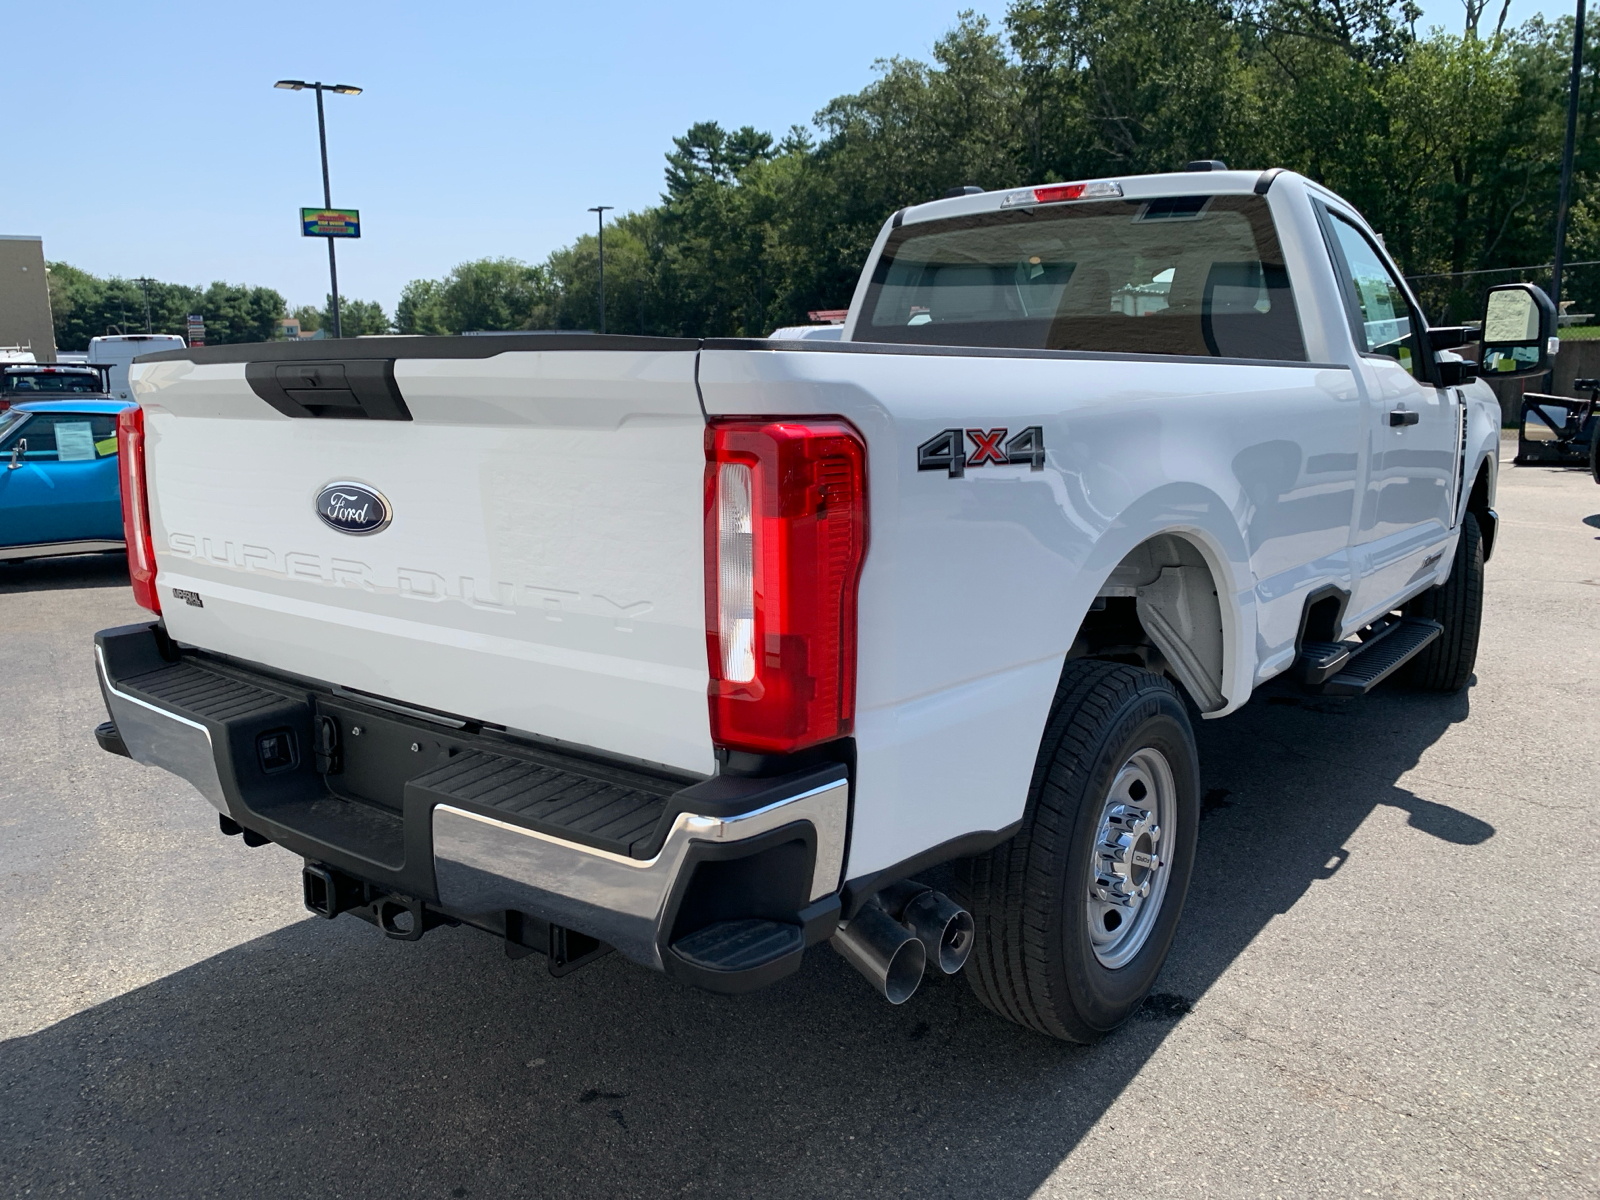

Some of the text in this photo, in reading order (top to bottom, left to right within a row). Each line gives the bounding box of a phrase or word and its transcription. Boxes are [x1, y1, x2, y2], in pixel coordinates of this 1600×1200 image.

[327, 492, 369, 524] Ford
[168, 532, 655, 633] SUPER DUTY
